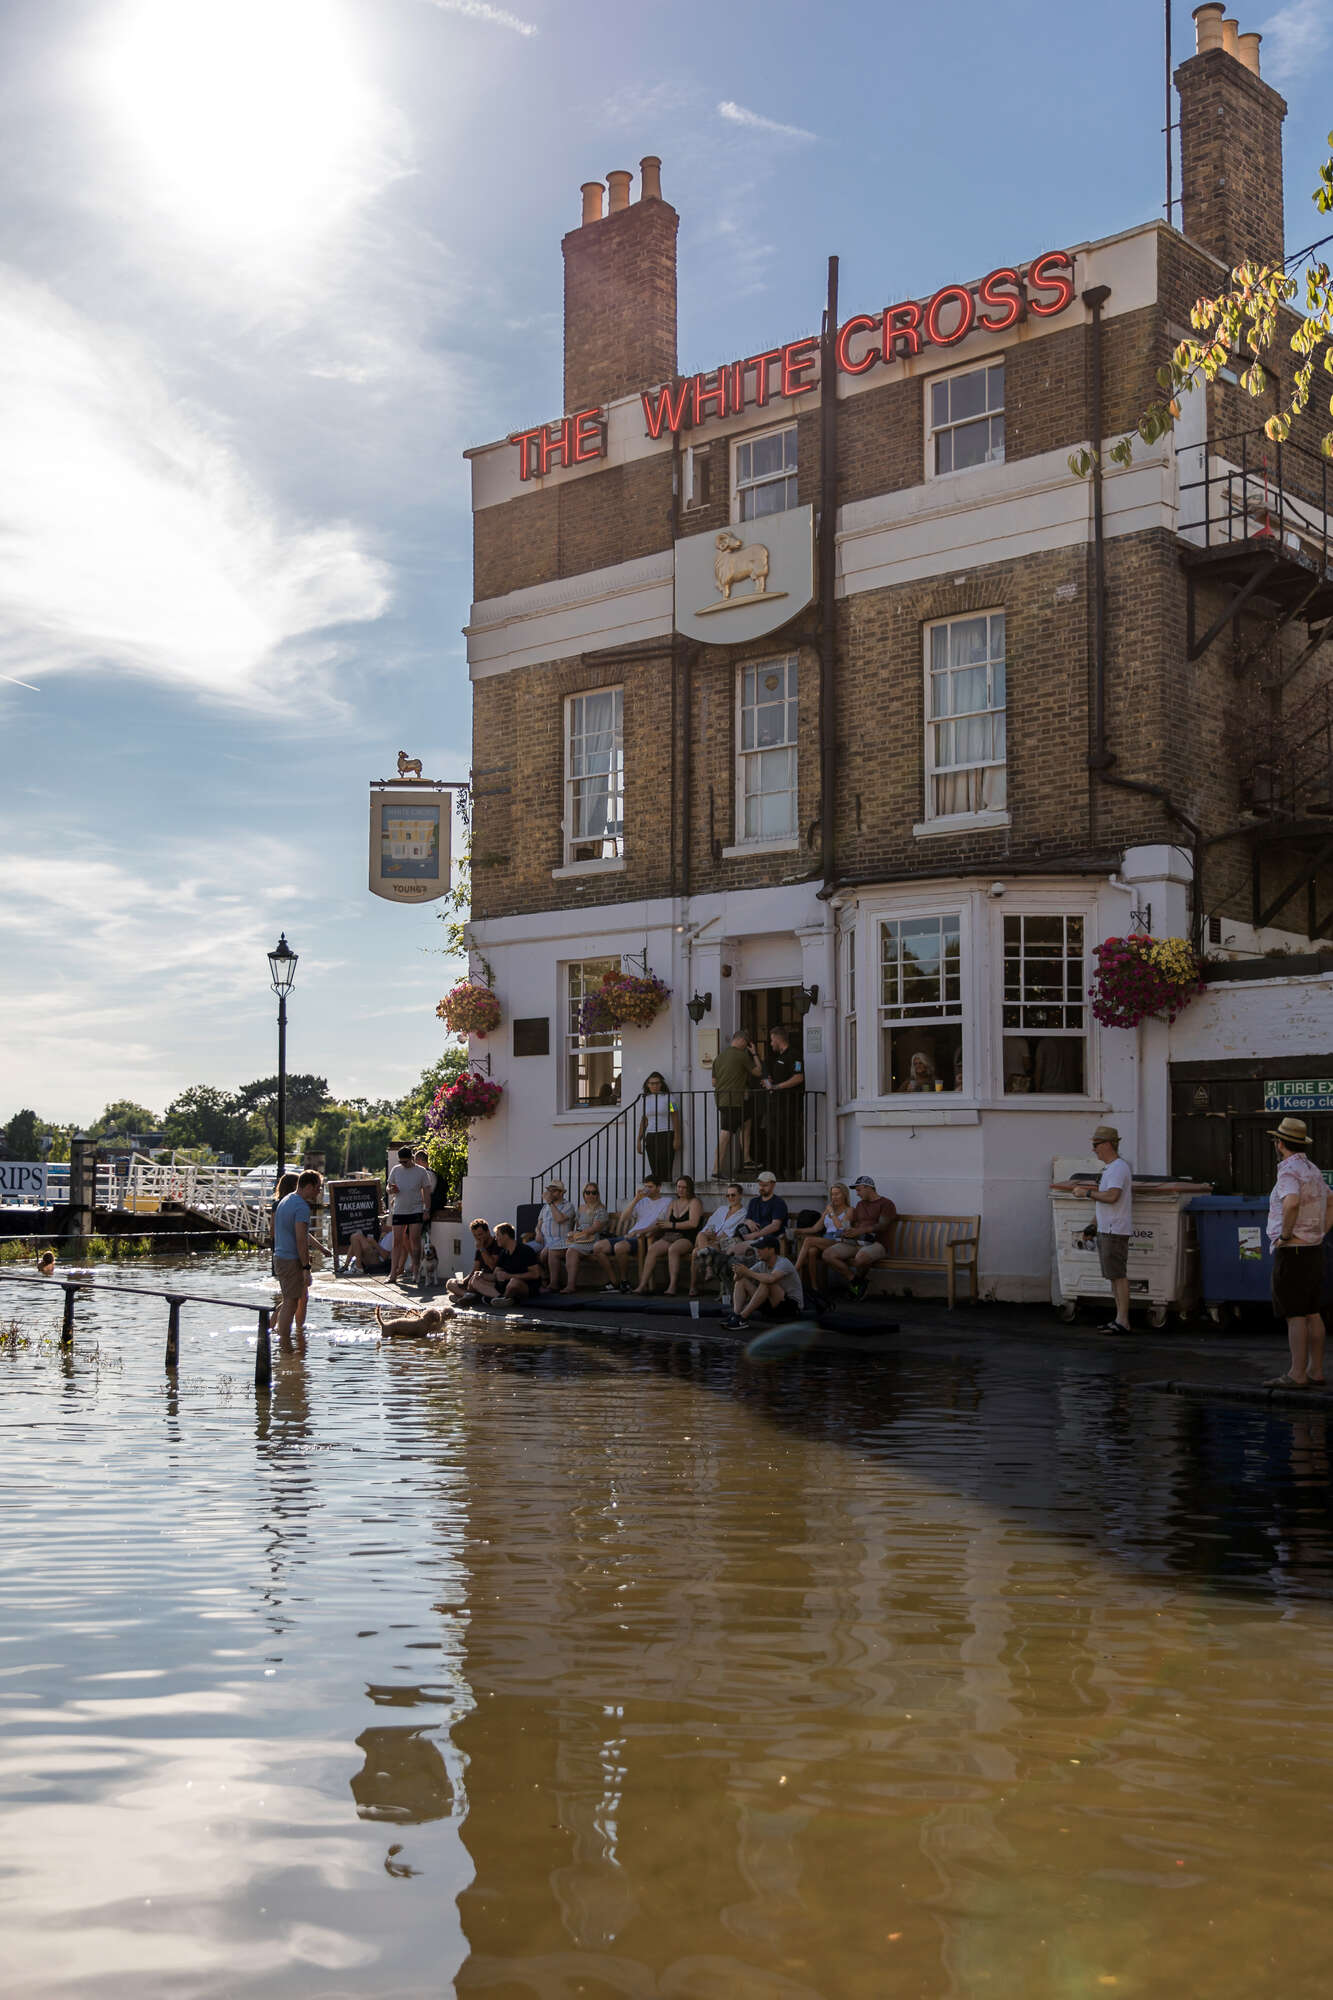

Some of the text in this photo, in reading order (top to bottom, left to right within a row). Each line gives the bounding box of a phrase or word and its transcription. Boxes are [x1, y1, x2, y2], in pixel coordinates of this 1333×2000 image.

[509, 250, 1075, 481] THE WHITE CROSS
[1283, 1082, 1315, 1094] FIRE
[1284, 1097, 1316, 1108] Keep
[338, 1201, 374, 1211] TAKEAWAY
